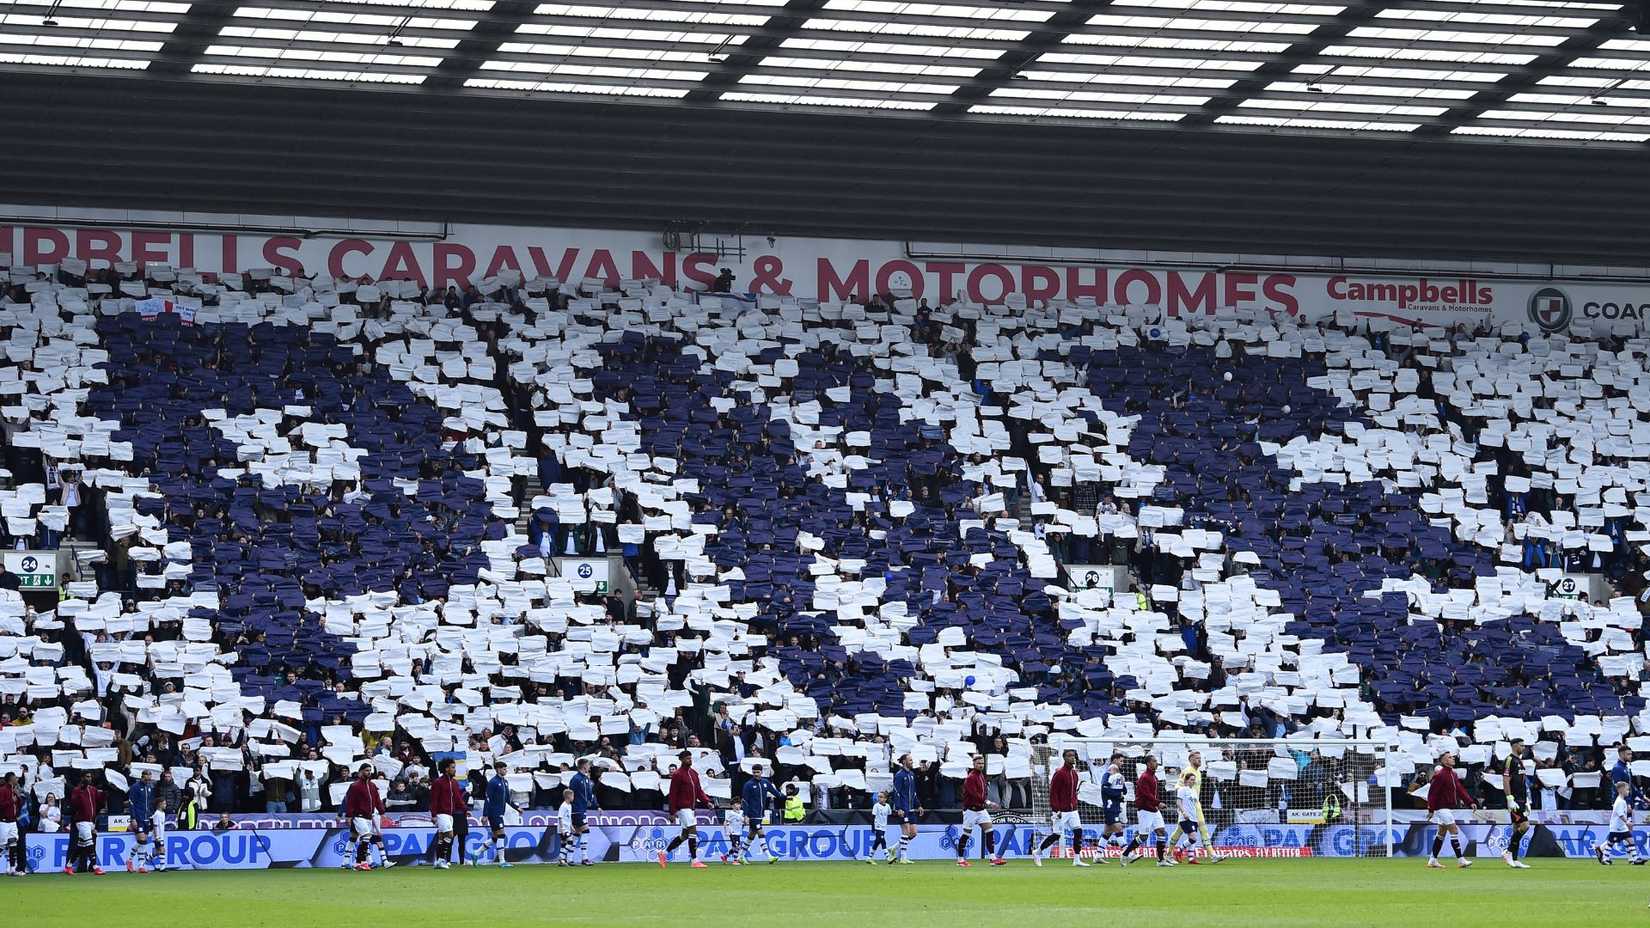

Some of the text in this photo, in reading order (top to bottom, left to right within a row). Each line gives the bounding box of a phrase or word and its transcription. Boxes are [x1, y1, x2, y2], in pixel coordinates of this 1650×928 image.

[0, 226, 1299, 318] PBELLS CARAVANS & MOTORHOMES
[1326, 275, 1493, 309] Campbells
[1408, 303, 1440, 312] Caravans
[1448, 305, 1492, 313] Motorhomes
[22, 559, 37, 569] 24
[579, 566, 592, 576] 25
[1086, 573, 1099, 583] 26
[1563, 581, 1575, 591] 27
[54, 837, 128, 867] PR
[144, 835, 271, 865] ROUP
